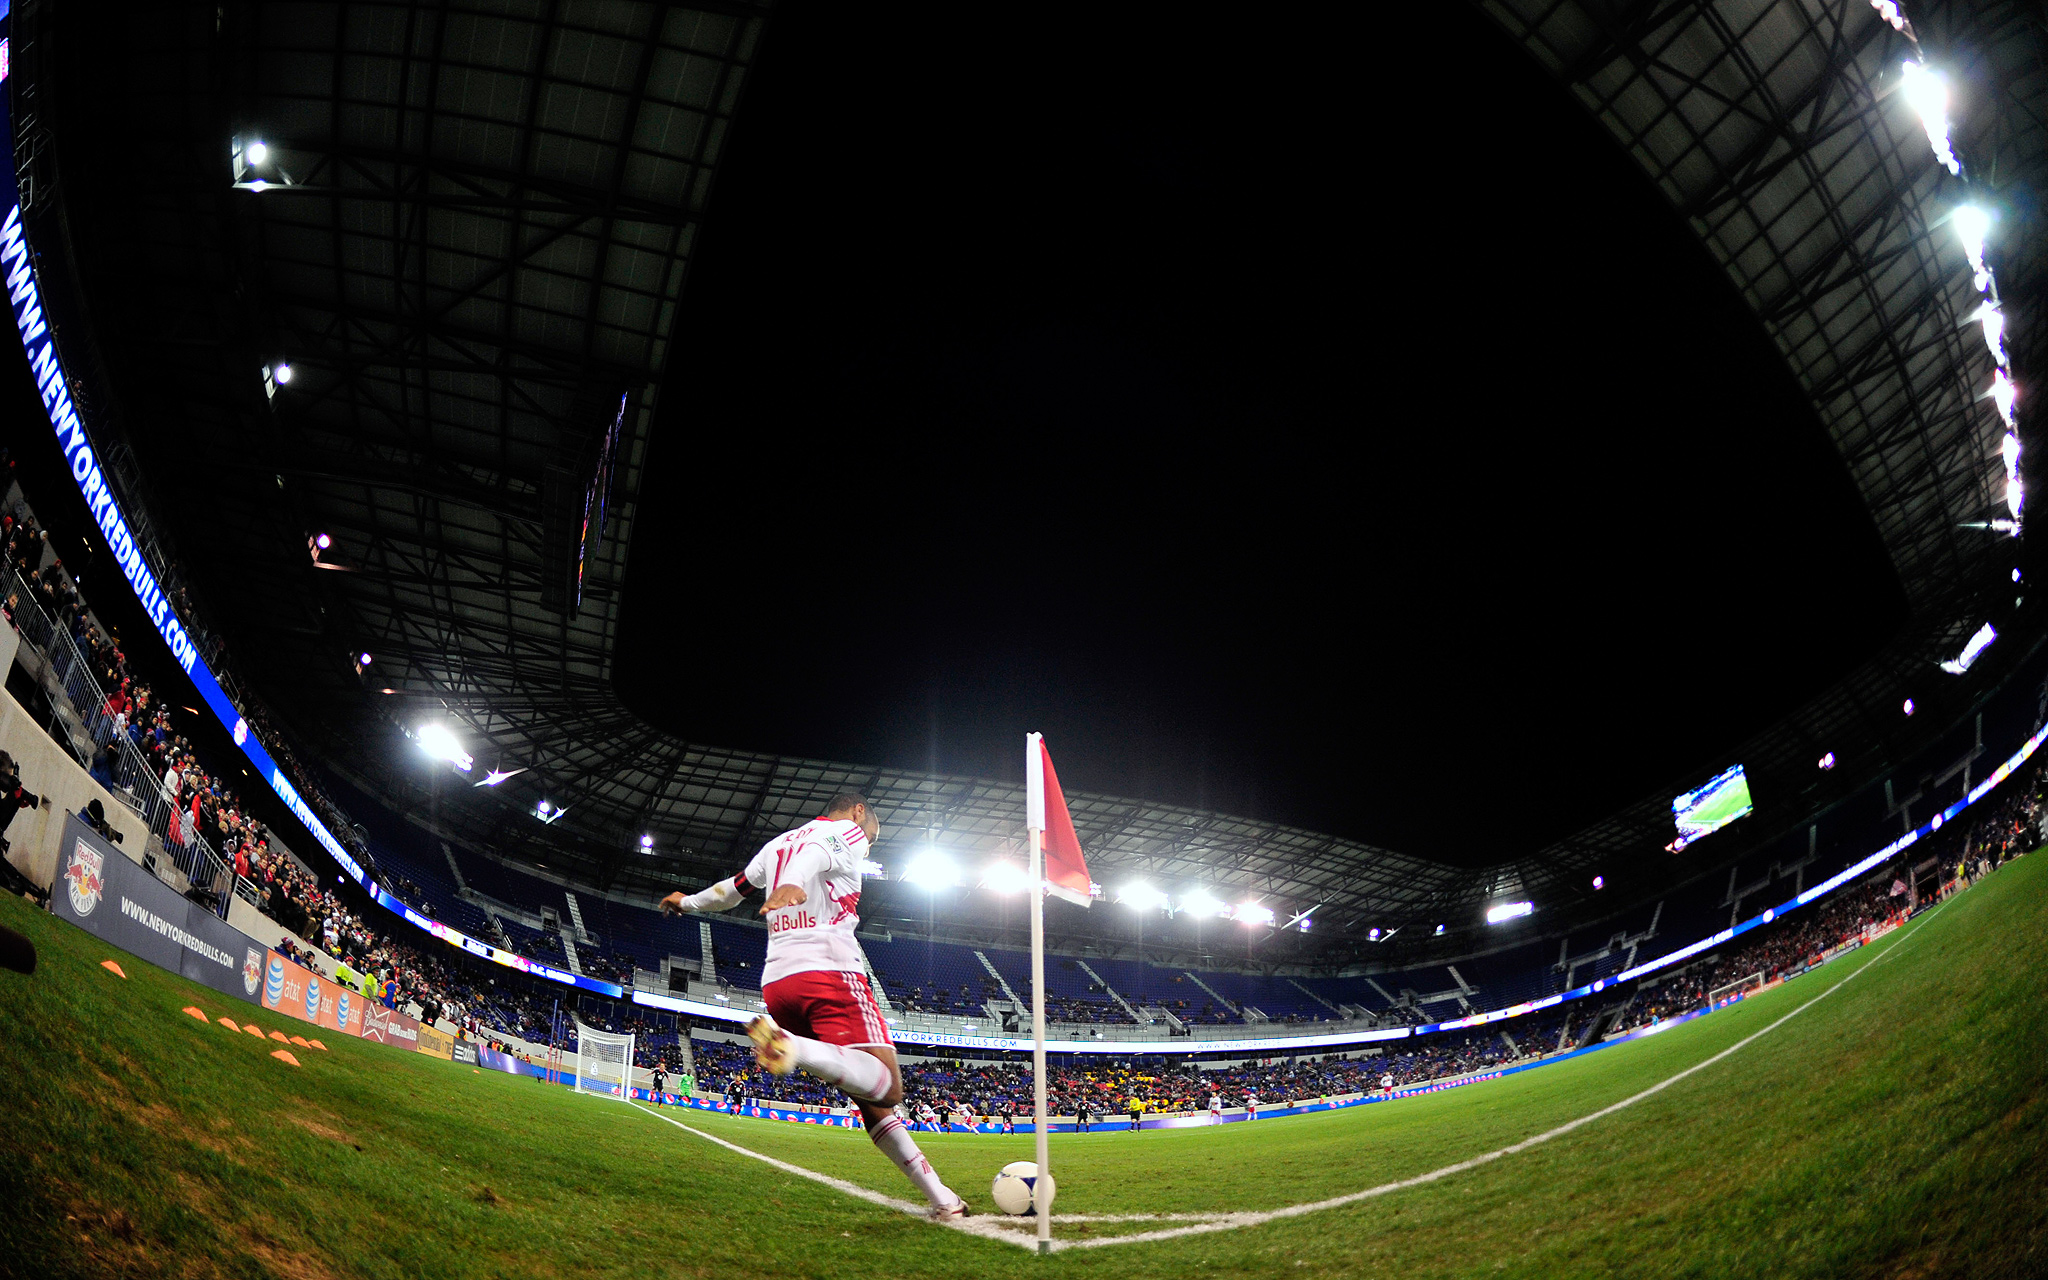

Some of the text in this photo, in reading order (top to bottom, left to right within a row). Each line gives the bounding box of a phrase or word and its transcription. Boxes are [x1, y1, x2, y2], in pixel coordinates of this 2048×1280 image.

[0, 204, 198, 675] WWW.NEWYORKREDBULLS.COM
[77, 845, 90, 862] Red
[782, 910, 817, 931] Bulls
[121, 896, 235, 970] WWW.NEWYORKREDBULLS.COM
[891, 1031, 1018, 1048] WYORKREDBULLS.COM
